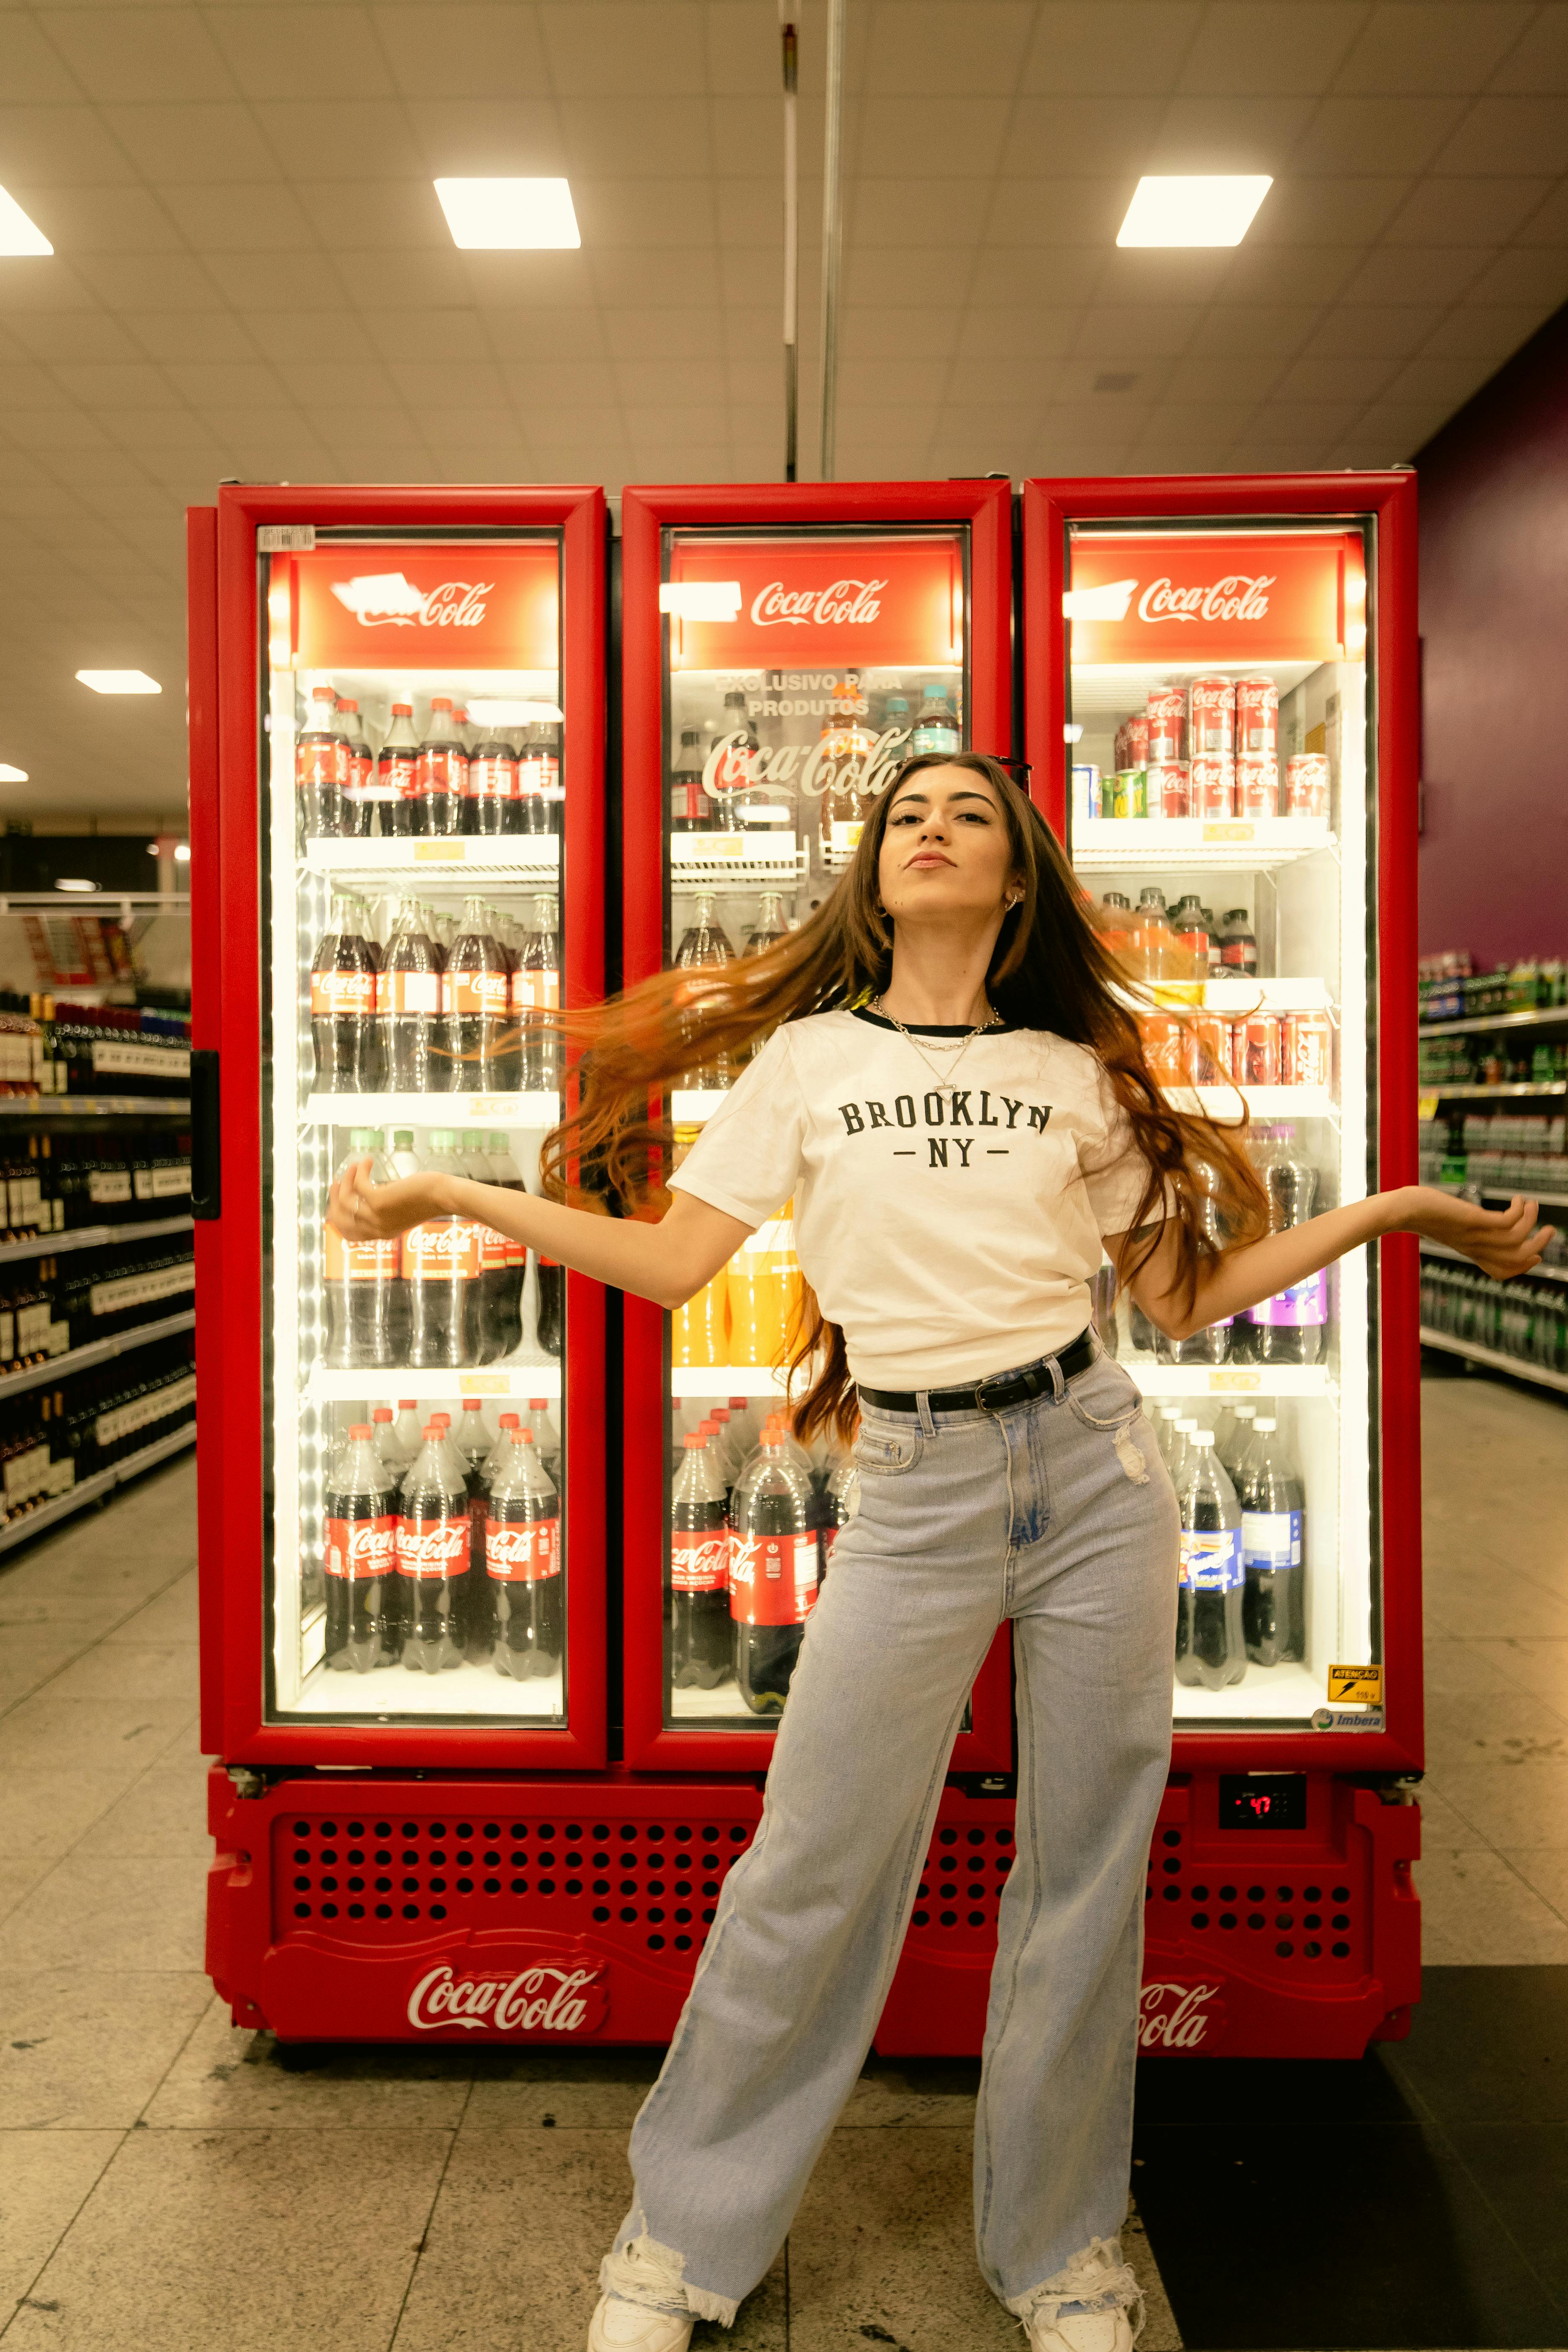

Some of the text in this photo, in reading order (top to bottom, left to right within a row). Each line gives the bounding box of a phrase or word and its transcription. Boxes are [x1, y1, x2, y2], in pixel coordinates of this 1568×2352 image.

[750, 579, 889, 626] Coca-Cola
[1138, 575, 1277, 622] Coca-Cola
[715, 674, 837, 692] EXCLUSIVO
[748, 699, 870, 717] PRODUTOS
[702, 727, 912, 799] Coca-Cola
[839, 1090, 1053, 1136] BROOKLYN
[928, 1138, 975, 1167] NY
[1336, 1713, 1381, 1726] Imbera
[407, 1966, 599, 2030] Coca-Cola
